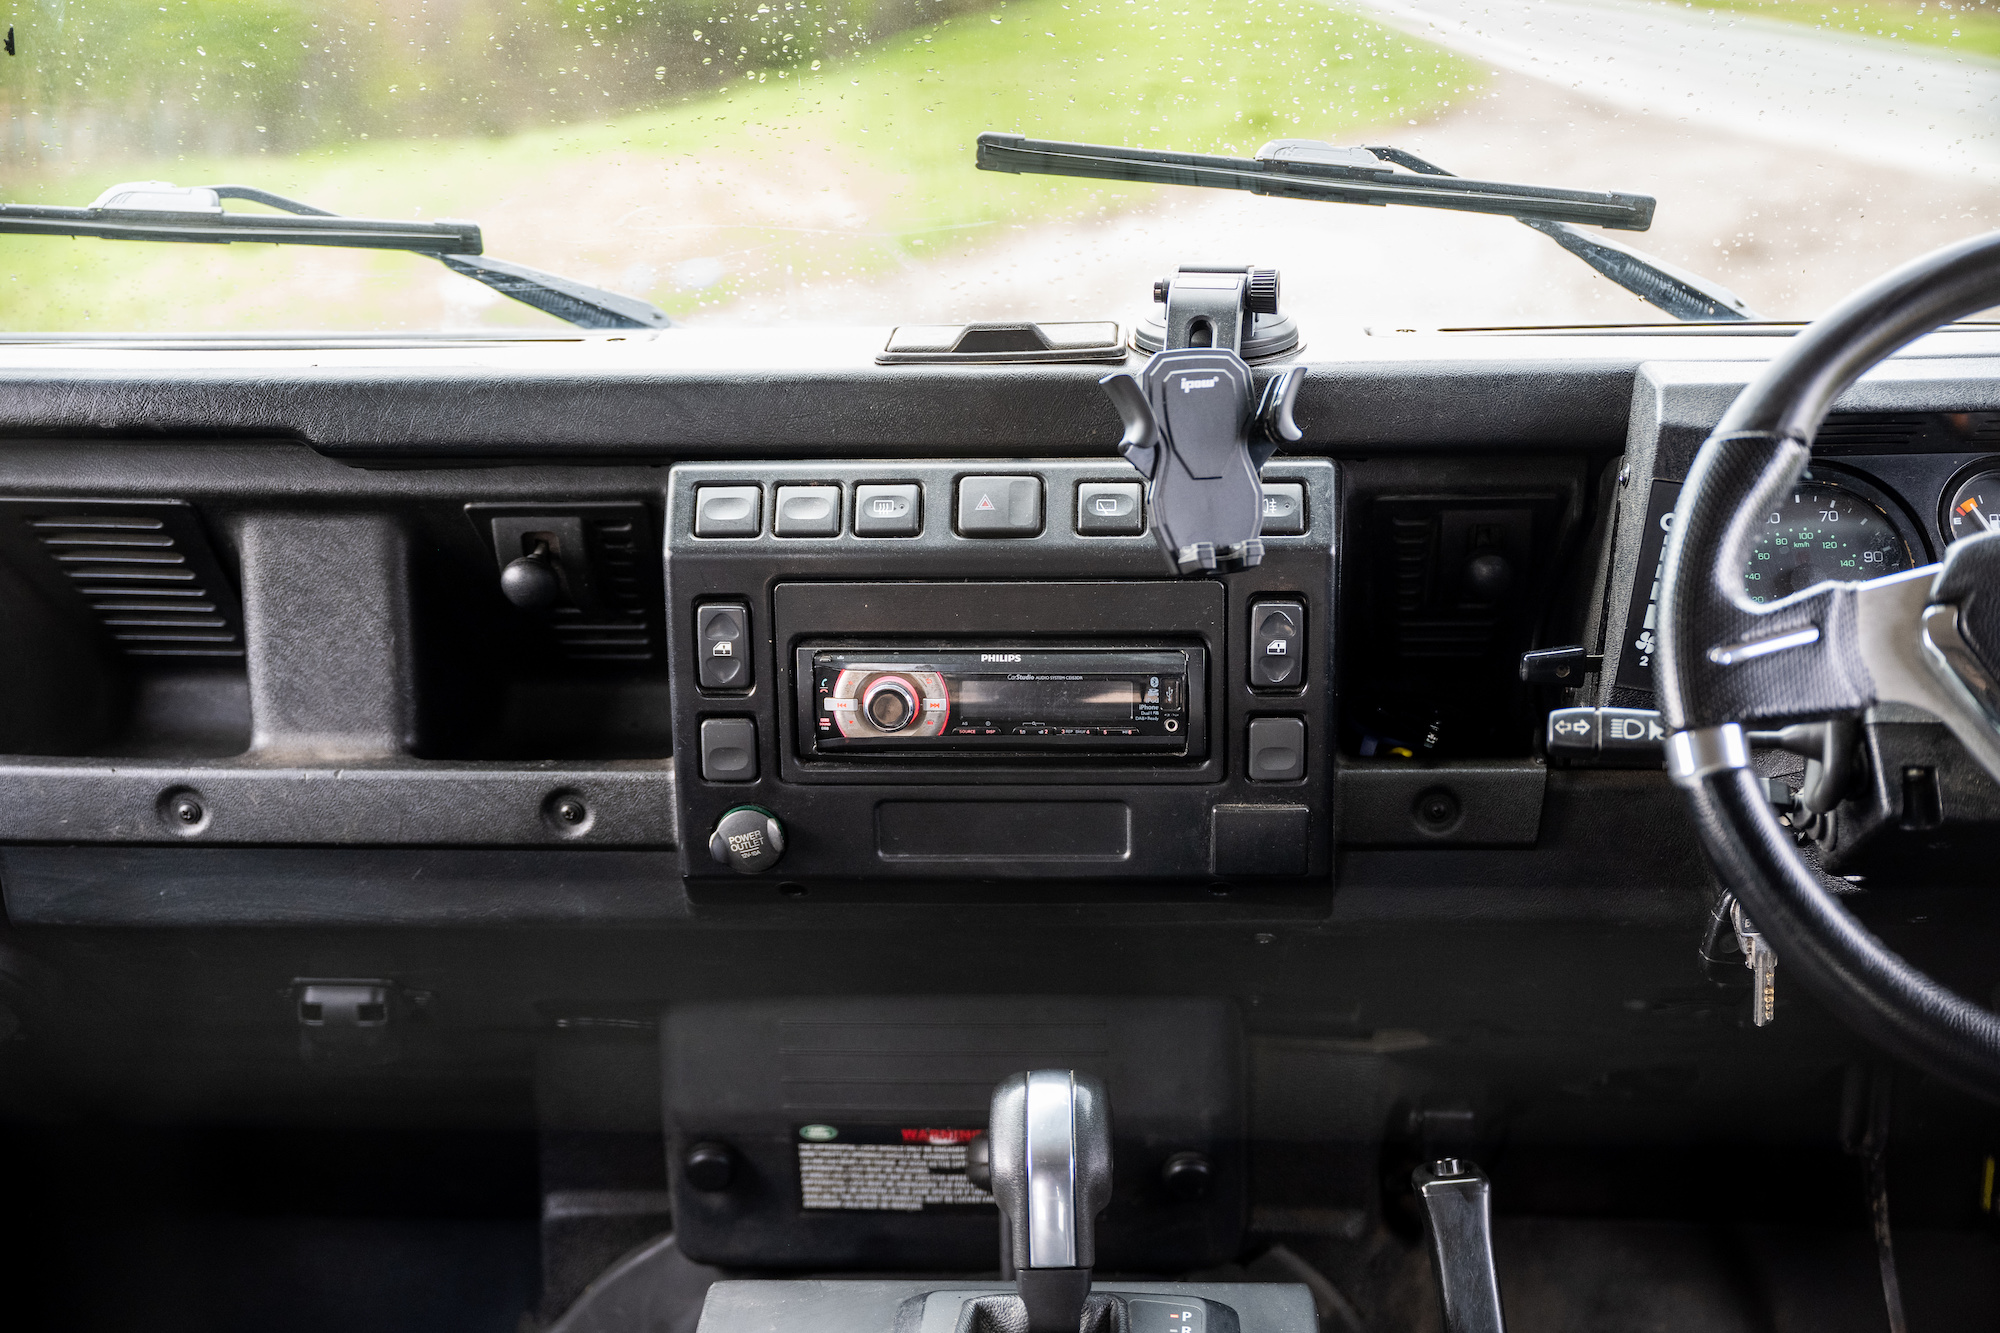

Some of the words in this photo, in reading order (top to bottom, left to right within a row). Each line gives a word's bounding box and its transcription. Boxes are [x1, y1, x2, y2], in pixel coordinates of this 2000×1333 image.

[1819, 511, 1839, 522] 70
[1953, 517, 1962, 525] E
[1798, 532, 1814, 540] 100
[1822, 541, 1837, 549] 120
[1758, 552, 1770, 560] 60
[1863, 551, 1884, 563] 90
[981, 654, 1022, 662] PHILIPS
[1639, 656, 1649, 667] 2
[728, 830, 762, 844] POWER
[730, 837, 764, 852] OUTLET
[1182, 1311, 1192, 1322] P
